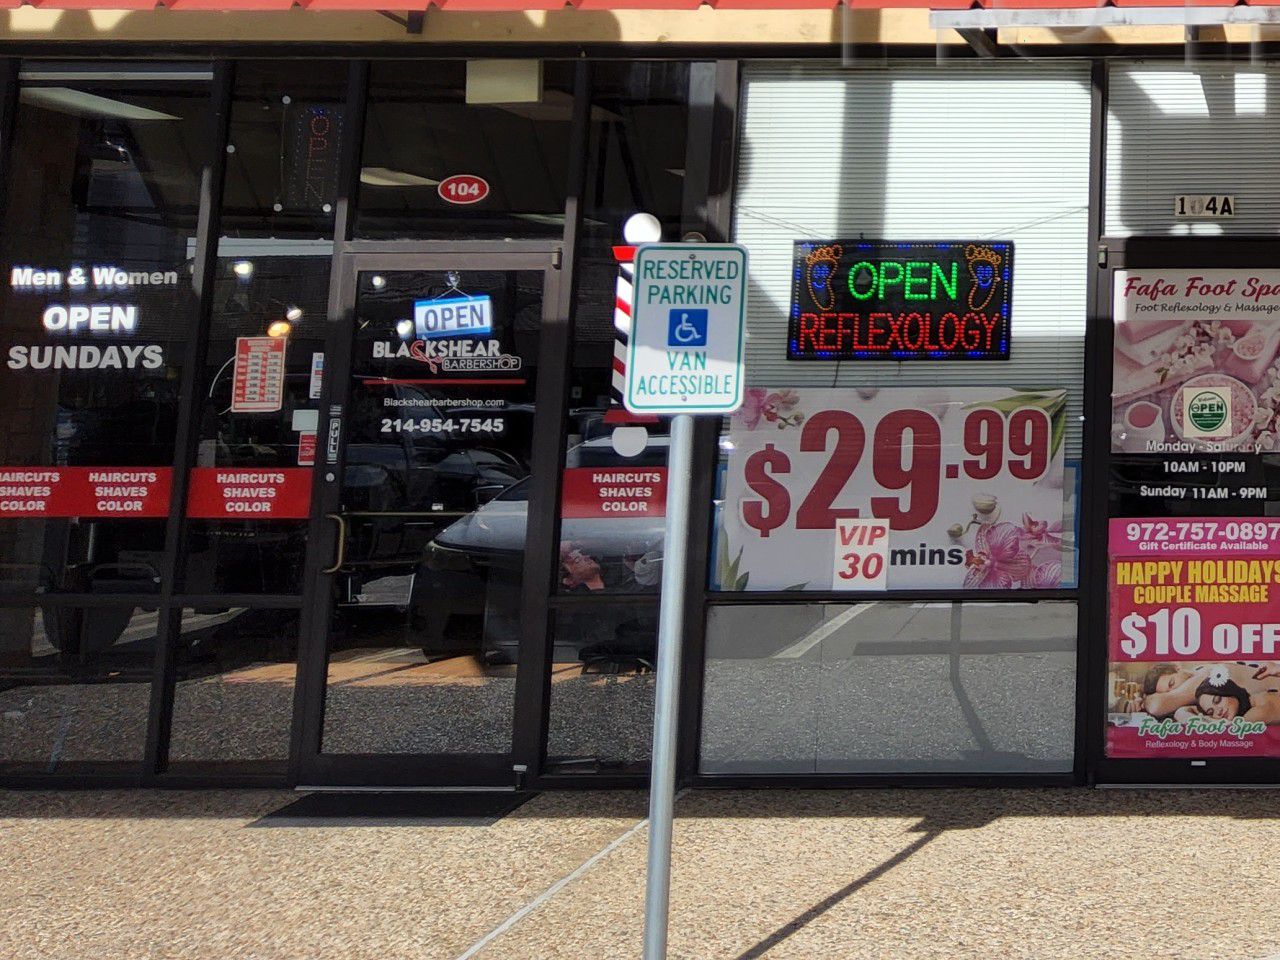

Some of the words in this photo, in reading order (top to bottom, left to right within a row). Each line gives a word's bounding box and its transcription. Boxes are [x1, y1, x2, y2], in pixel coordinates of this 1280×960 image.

[448, 183, 480, 196] 104
[11, 268, 61, 285] Men
[67, 267, 86, 285] &
[93, 267, 178, 285] Women
[643, 260, 739, 280] RESERVED
[848, 261, 958, 301] OPEN
[647, 285, 732, 305] PARKING
[1123, 277, 1179, 301] Fafa
[1185, 277, 1238, 297] Foot
[1135, 303, 1160, 314] Foot
[1161, 302, 1222, 315] Reflexology
[1223, 304, 1232, 313] &
[43, 306, 136, 330] OPEN
[424, 304, 485, 332] OPEN
[799, 313, 1000, 351] REFLEXOLOGY
[373, 340, 500, 359] BLACKSHEAR
[7, 345, 163, 370] SUNDAYS
[444, 358, 518, 370] BARBERSHOP
[666, 351, 707, 371] VAN
[636, 374, 733, 396] ACCESSIBLE
[383, 397, 505, 409] Blackshearbarbershop.com
[381, 418, 504, 433] 214-954-7545
[329, 422, 339, 453] PULL
[1146, 440, 1196, 454] Monday
[742, 409, 1049, 538] $29.99
[1163, 461, 1199, 473] 10AM
[1211, 461, 1246, 473] 10PM
[0, 472, 60, 483] AIRCUTS
[89, 472, 157, 483] HAIRCUTS
[216, 473, 285, 484] HAIRCUTS
[592, 473, 661, 483] HAIRCUTS
[95, 486, 148, 497] SHAVES
[223, 487, 276, 498] SHAVES
[599, 487, 652, 497] SHAVES
[1140, 485, 1187, 499] Sunday
[1192, 487, 1229, 499] 11AM
[1239, 487, 1268, 499] 9PM
[1, 500, 45, 511] COLOR
[97, 500, 142, 511] COLOR
[225, 501, 271, 512] COLOR
[602, 501, 648, 511] COLOR
[839, 525, 886, 546] VIP
[1139, 542, 1158, 550] Gift
[1161, 541, 1217, 550] Certificate
[1220, 541, 1269, 550] Available
[838, 553, 883, 579] 30
[890, 543, 963, 566] mins
[1116, 561, 1183, 584] HAPPY
[1133, 586, 1191, 604] COUPLE
[1195, 585, 1268, 603] MASSAGE
[1120, 607, 1201, 658] $10
[1139, 718, 1182, 738] Fafa
[1186, 717, 1227, 734] Foot
[1229, 717, 1266, 739] Spa
[1145, 740, 1189, 749] Reflexology
[1199, 740, 1217, 749] Body
[1219, 740, 1253, 748] Massage
